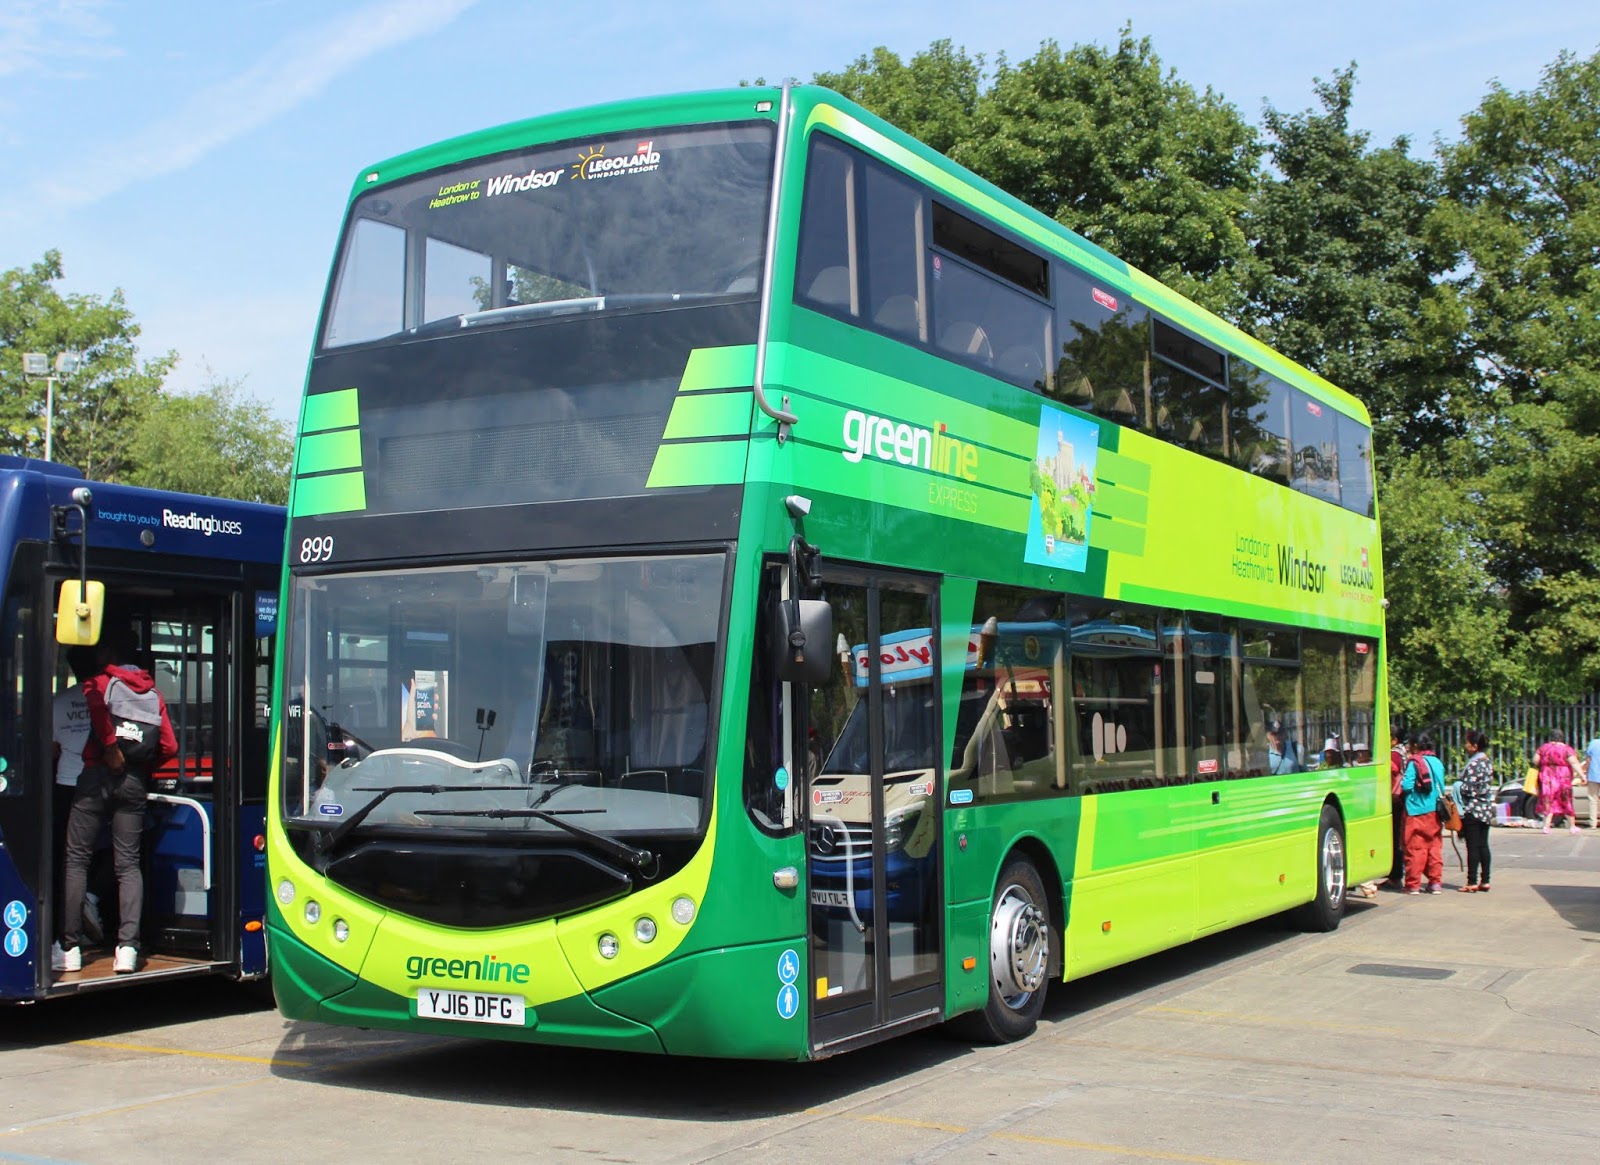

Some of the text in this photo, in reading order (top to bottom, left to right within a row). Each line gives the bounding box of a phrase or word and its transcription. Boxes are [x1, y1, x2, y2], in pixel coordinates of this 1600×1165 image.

[589, 141, 661, 173] LEGOLAND
[486, 169, 564, 197] Windsor
[588, 164, 659, 180] WINDSOR RESORT
[429, 190, 480, 209] Heathrow to
[438, 179, 481, 197] London or
[842, 409, 979, 482] greenline
[928, 482, 977, 514] EXPRESS
[98, 509, 160, 527] brought to you by
[300, 535, 334, 563] 899
[1235, 531, 1271, 559] London or
[1232, 554, 1274, 584] Heathrow to
[1277, 543, 1327, 594] Windsor
[1340, 557, 1374, 591] LEGOLAND
[416, 690, 429, 701] buy.
[416, 701, 432, 709] scan.
[406, 954, 531, 984] greenline
[429, 992, 512, 1019] YJ16 DFG
